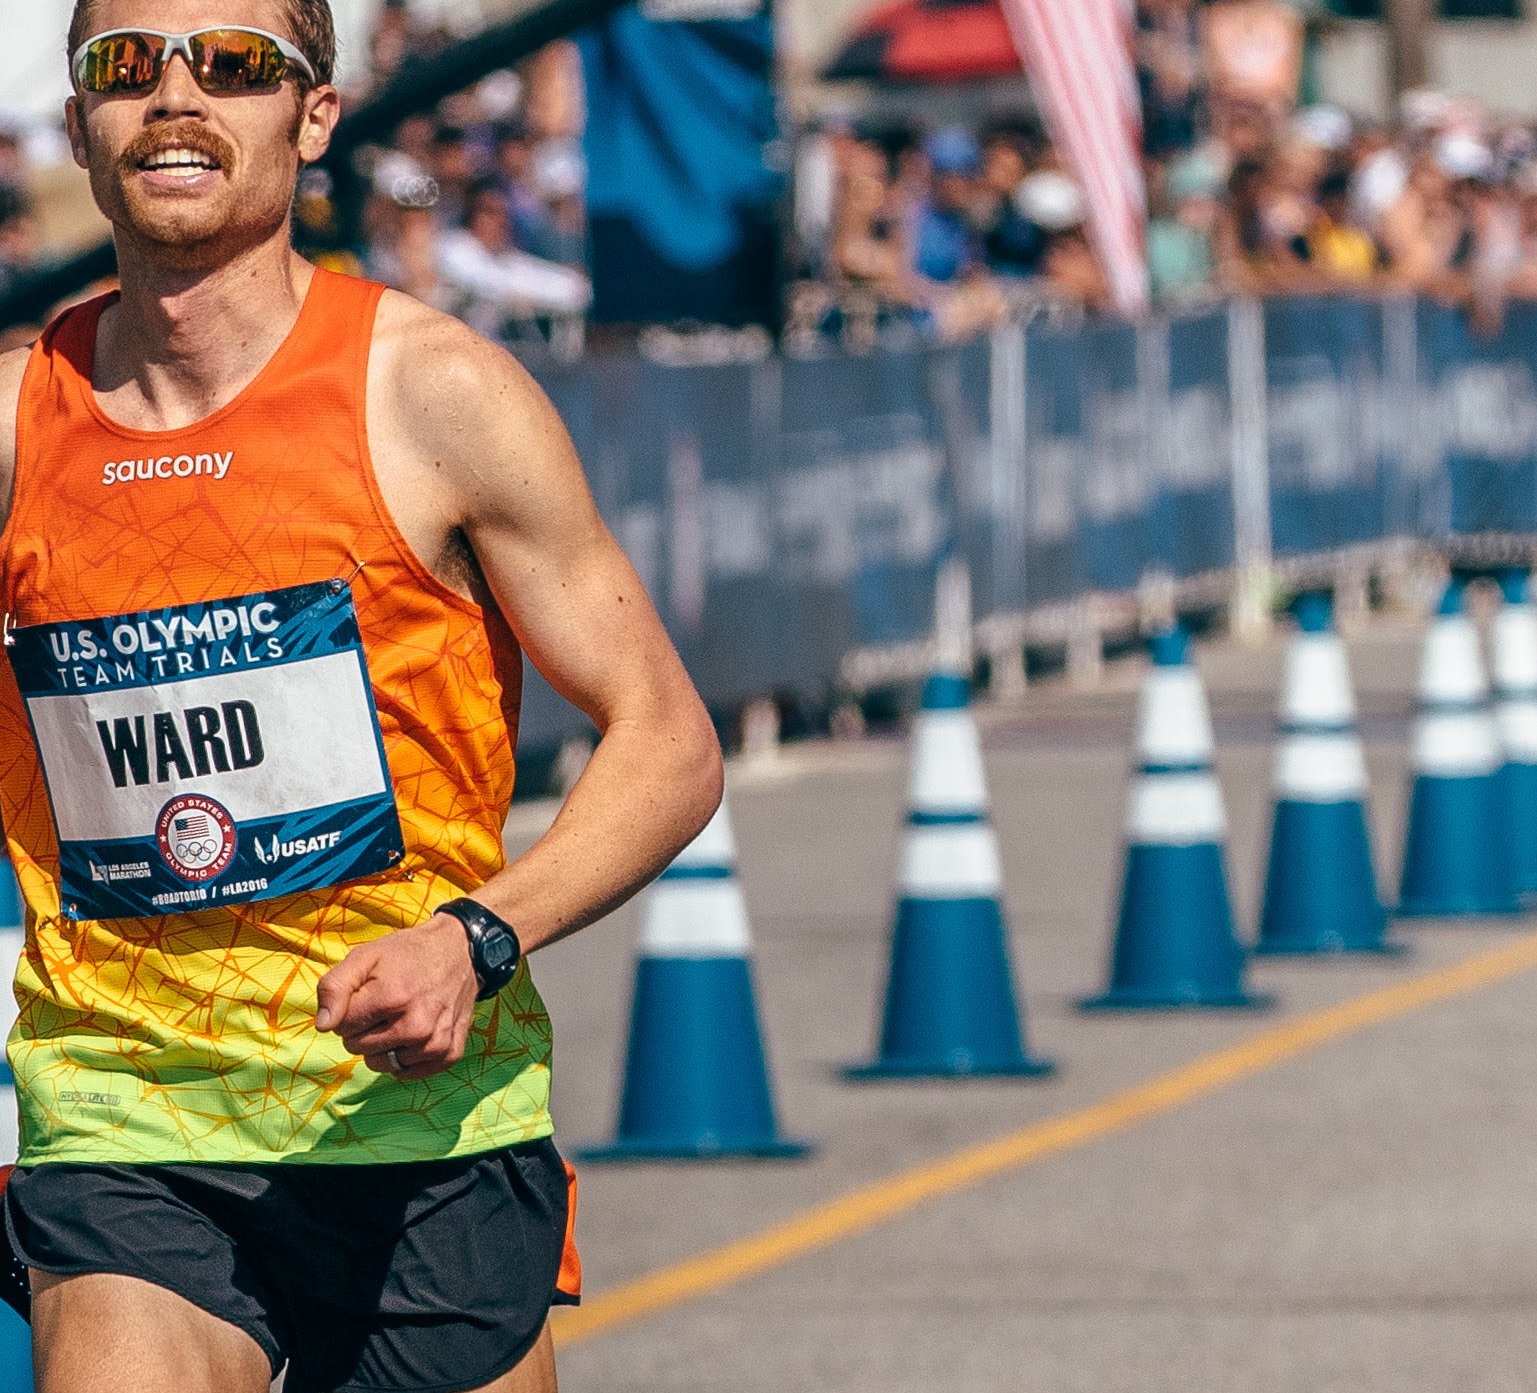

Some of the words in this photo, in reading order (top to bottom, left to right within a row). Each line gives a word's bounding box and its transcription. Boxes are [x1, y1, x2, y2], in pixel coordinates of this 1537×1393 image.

[101, 451, 234, 486] saucony
[50, 630, 107, 662] U.S.
[112, 602, 280, 655] OLYMPIC
[57, 660, 135, 688] TEAM
[151, 637, 283, 677] TRIALS
[96, 699, 264, 788] WARD
[161, 801, 185, 828] UNITED
[187, 799, 223, 820] STATES
[165, 852, 207, 878] OLYMPIC
[212, 842, 232, 870] TEAM
[281, 830, 343, 857] USATF
[109, 868, 151, 881] MARATHON
[221, 878, 268, 896] #LA2016
